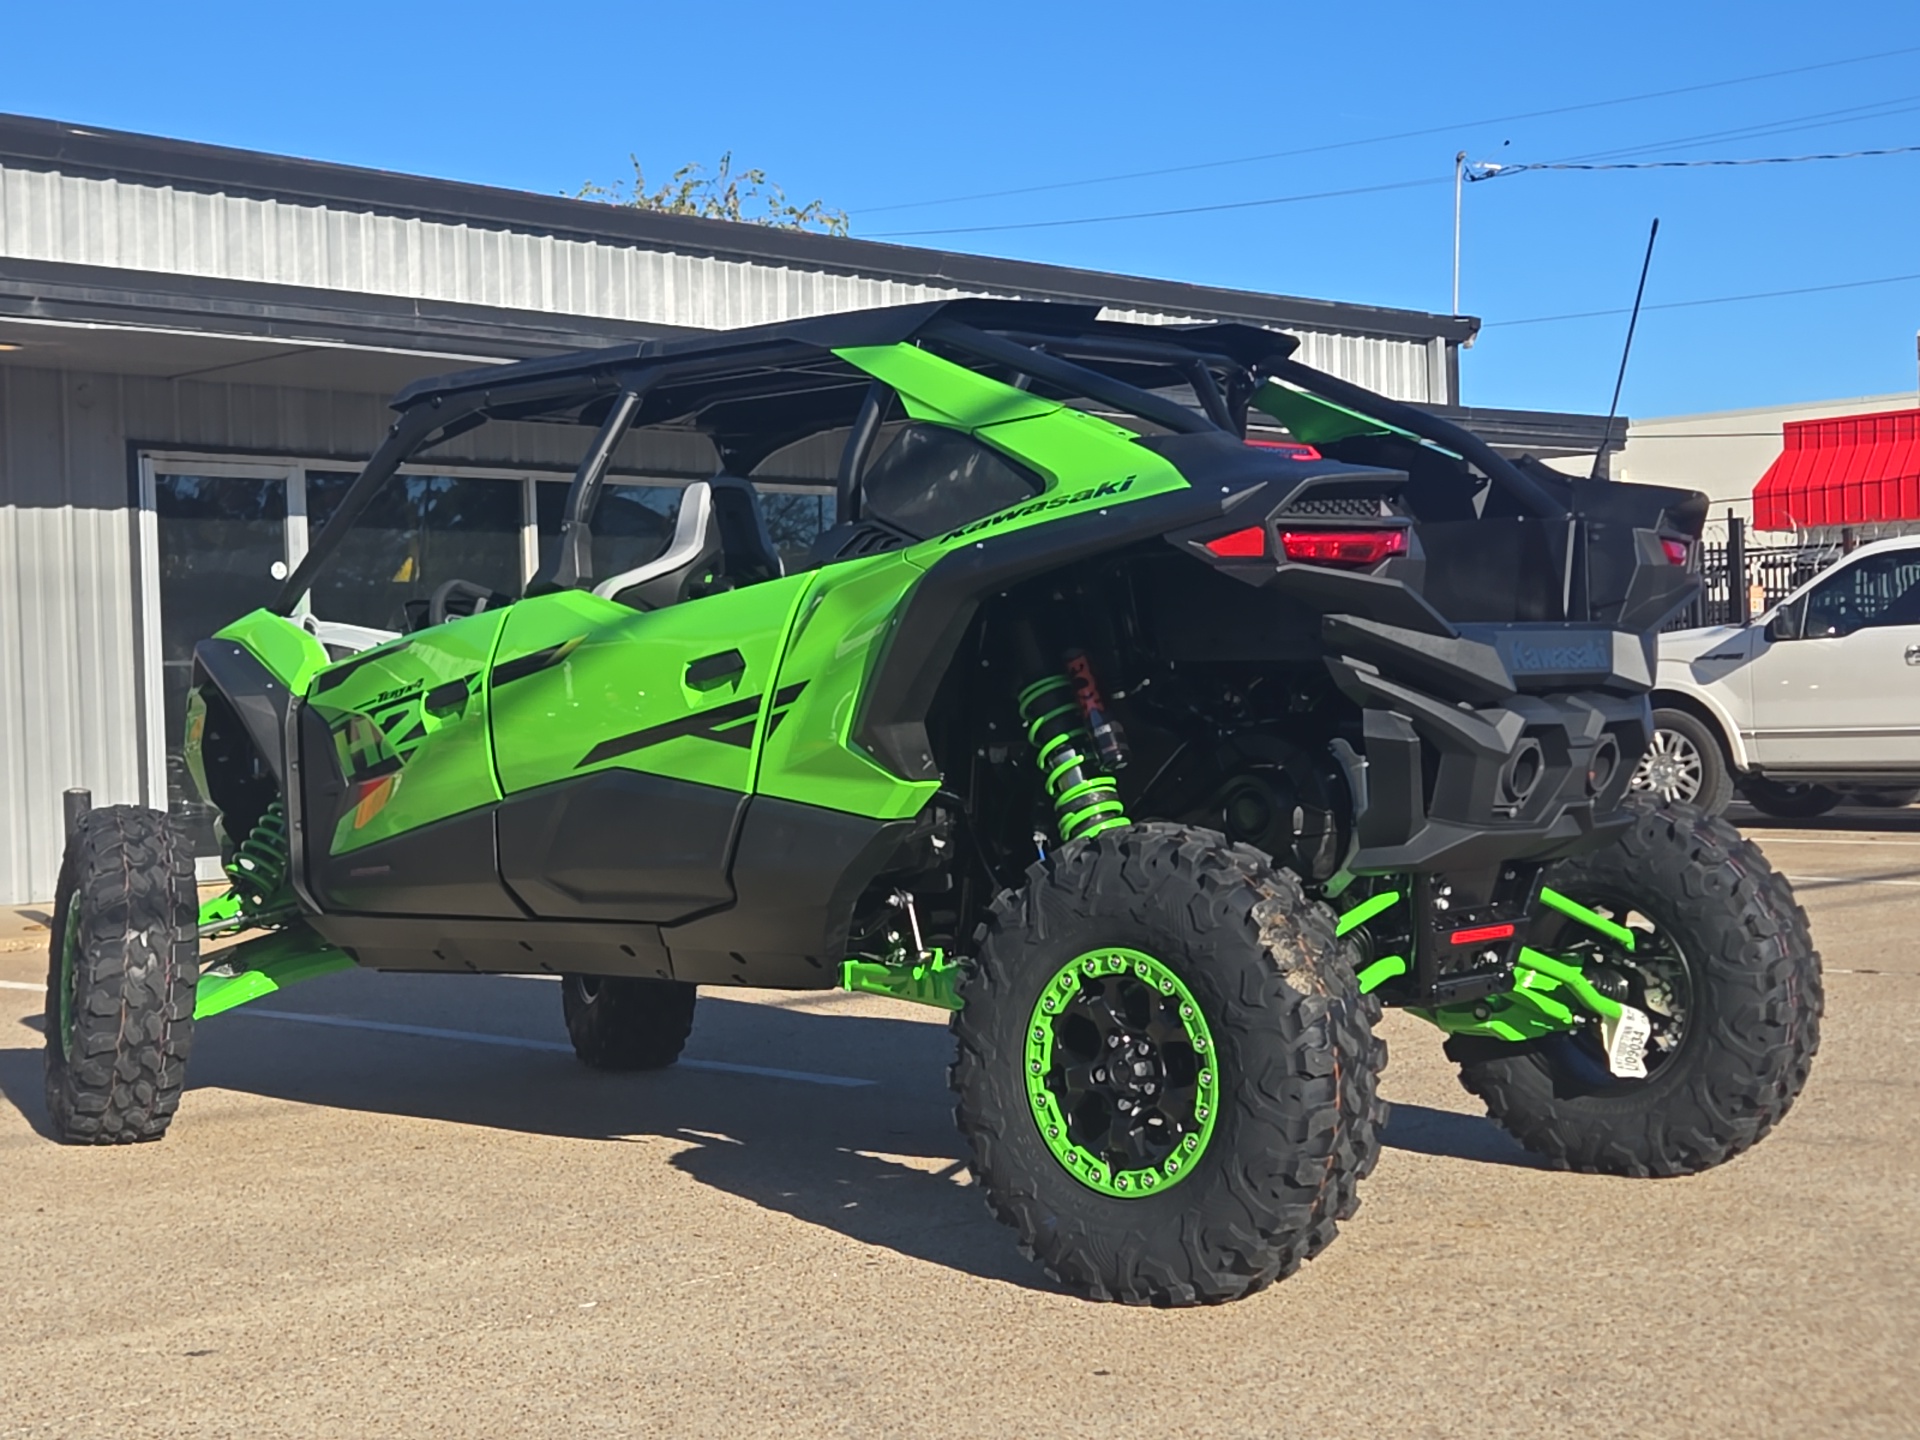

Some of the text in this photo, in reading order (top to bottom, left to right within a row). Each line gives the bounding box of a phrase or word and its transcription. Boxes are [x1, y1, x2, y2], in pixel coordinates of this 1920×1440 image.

[939, 475, 1136, 545] Kawasaki
[1509, 638, 1608, 669] Kawasaki
[333, 698, 428, 777] H2
